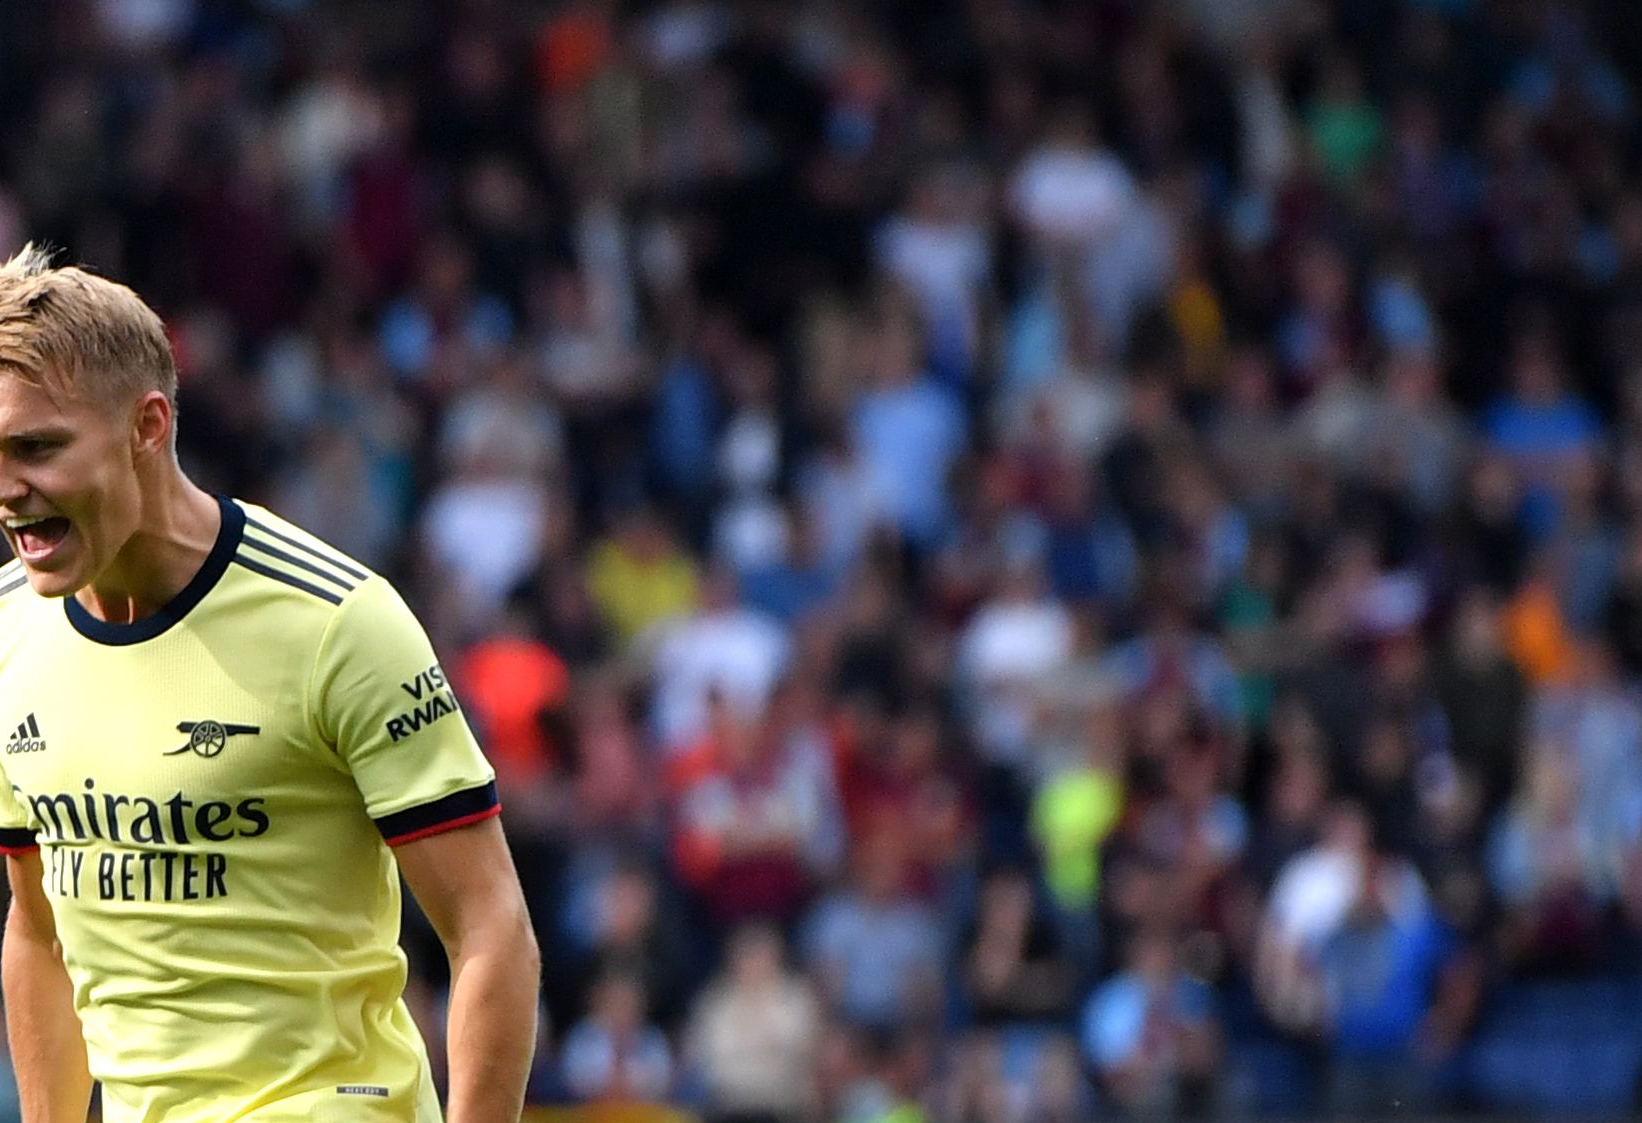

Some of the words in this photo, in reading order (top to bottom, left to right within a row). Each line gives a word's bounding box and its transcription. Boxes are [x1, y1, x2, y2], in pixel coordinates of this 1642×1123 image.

[6, 738, 46, 755] adidas
[13, 777, 270, 845] mirates
[98, 852, 228, 902] BETTER
